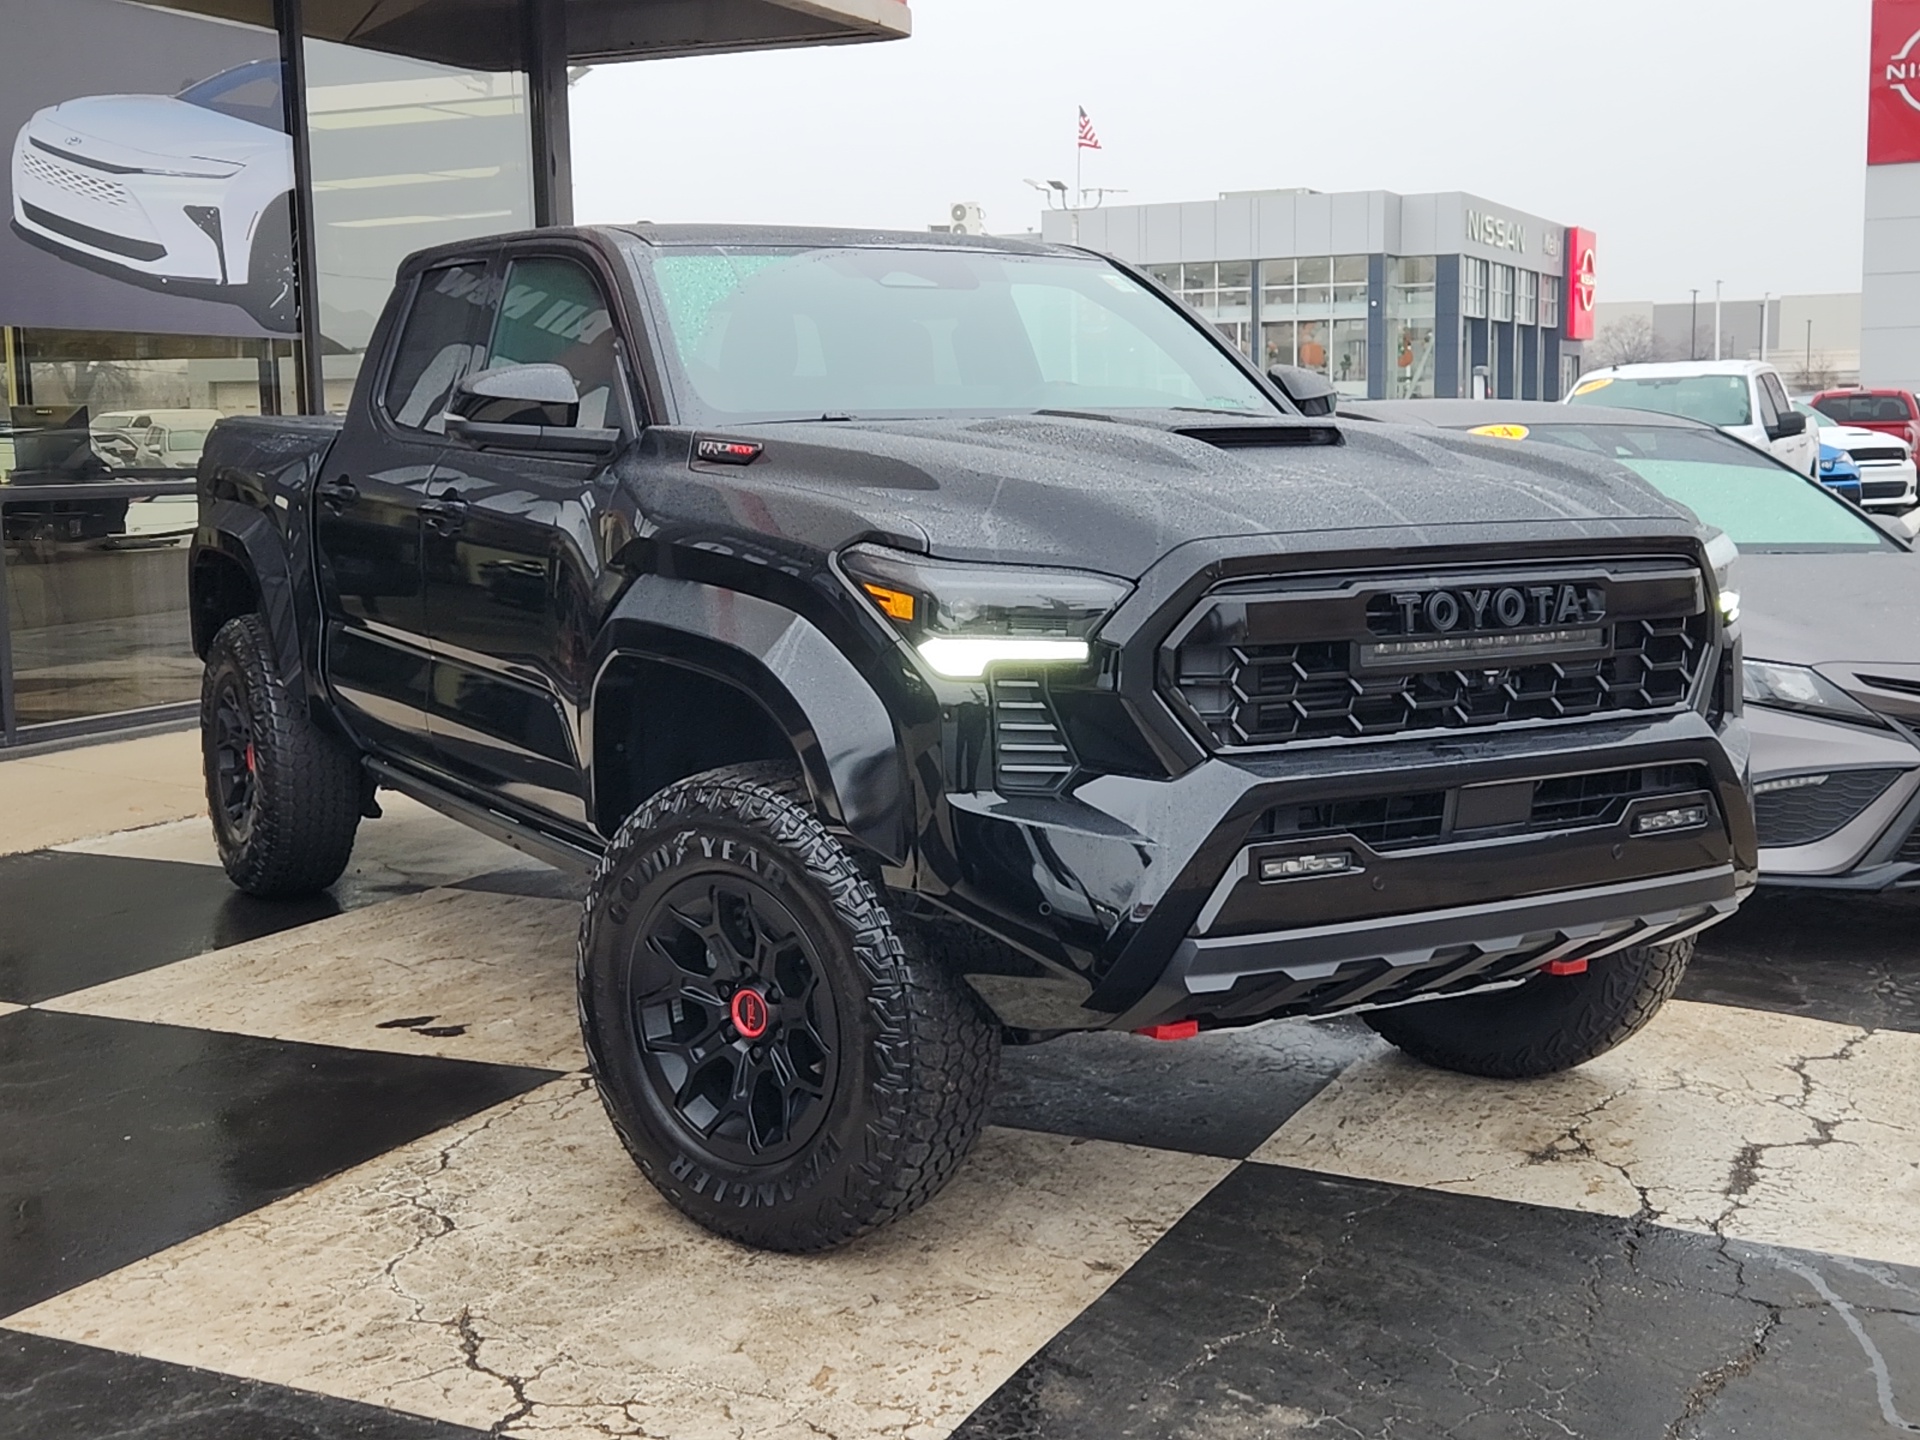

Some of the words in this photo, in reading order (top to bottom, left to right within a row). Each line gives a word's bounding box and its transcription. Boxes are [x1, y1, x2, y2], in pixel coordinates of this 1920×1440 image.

[1886, 62, 1920, 80] NI
[1466, 209, 1526, 254] NISSAN
[1391, 584, 1584, 632] TOYOTA
[608, 829, 787, 925] GOODYEAR
